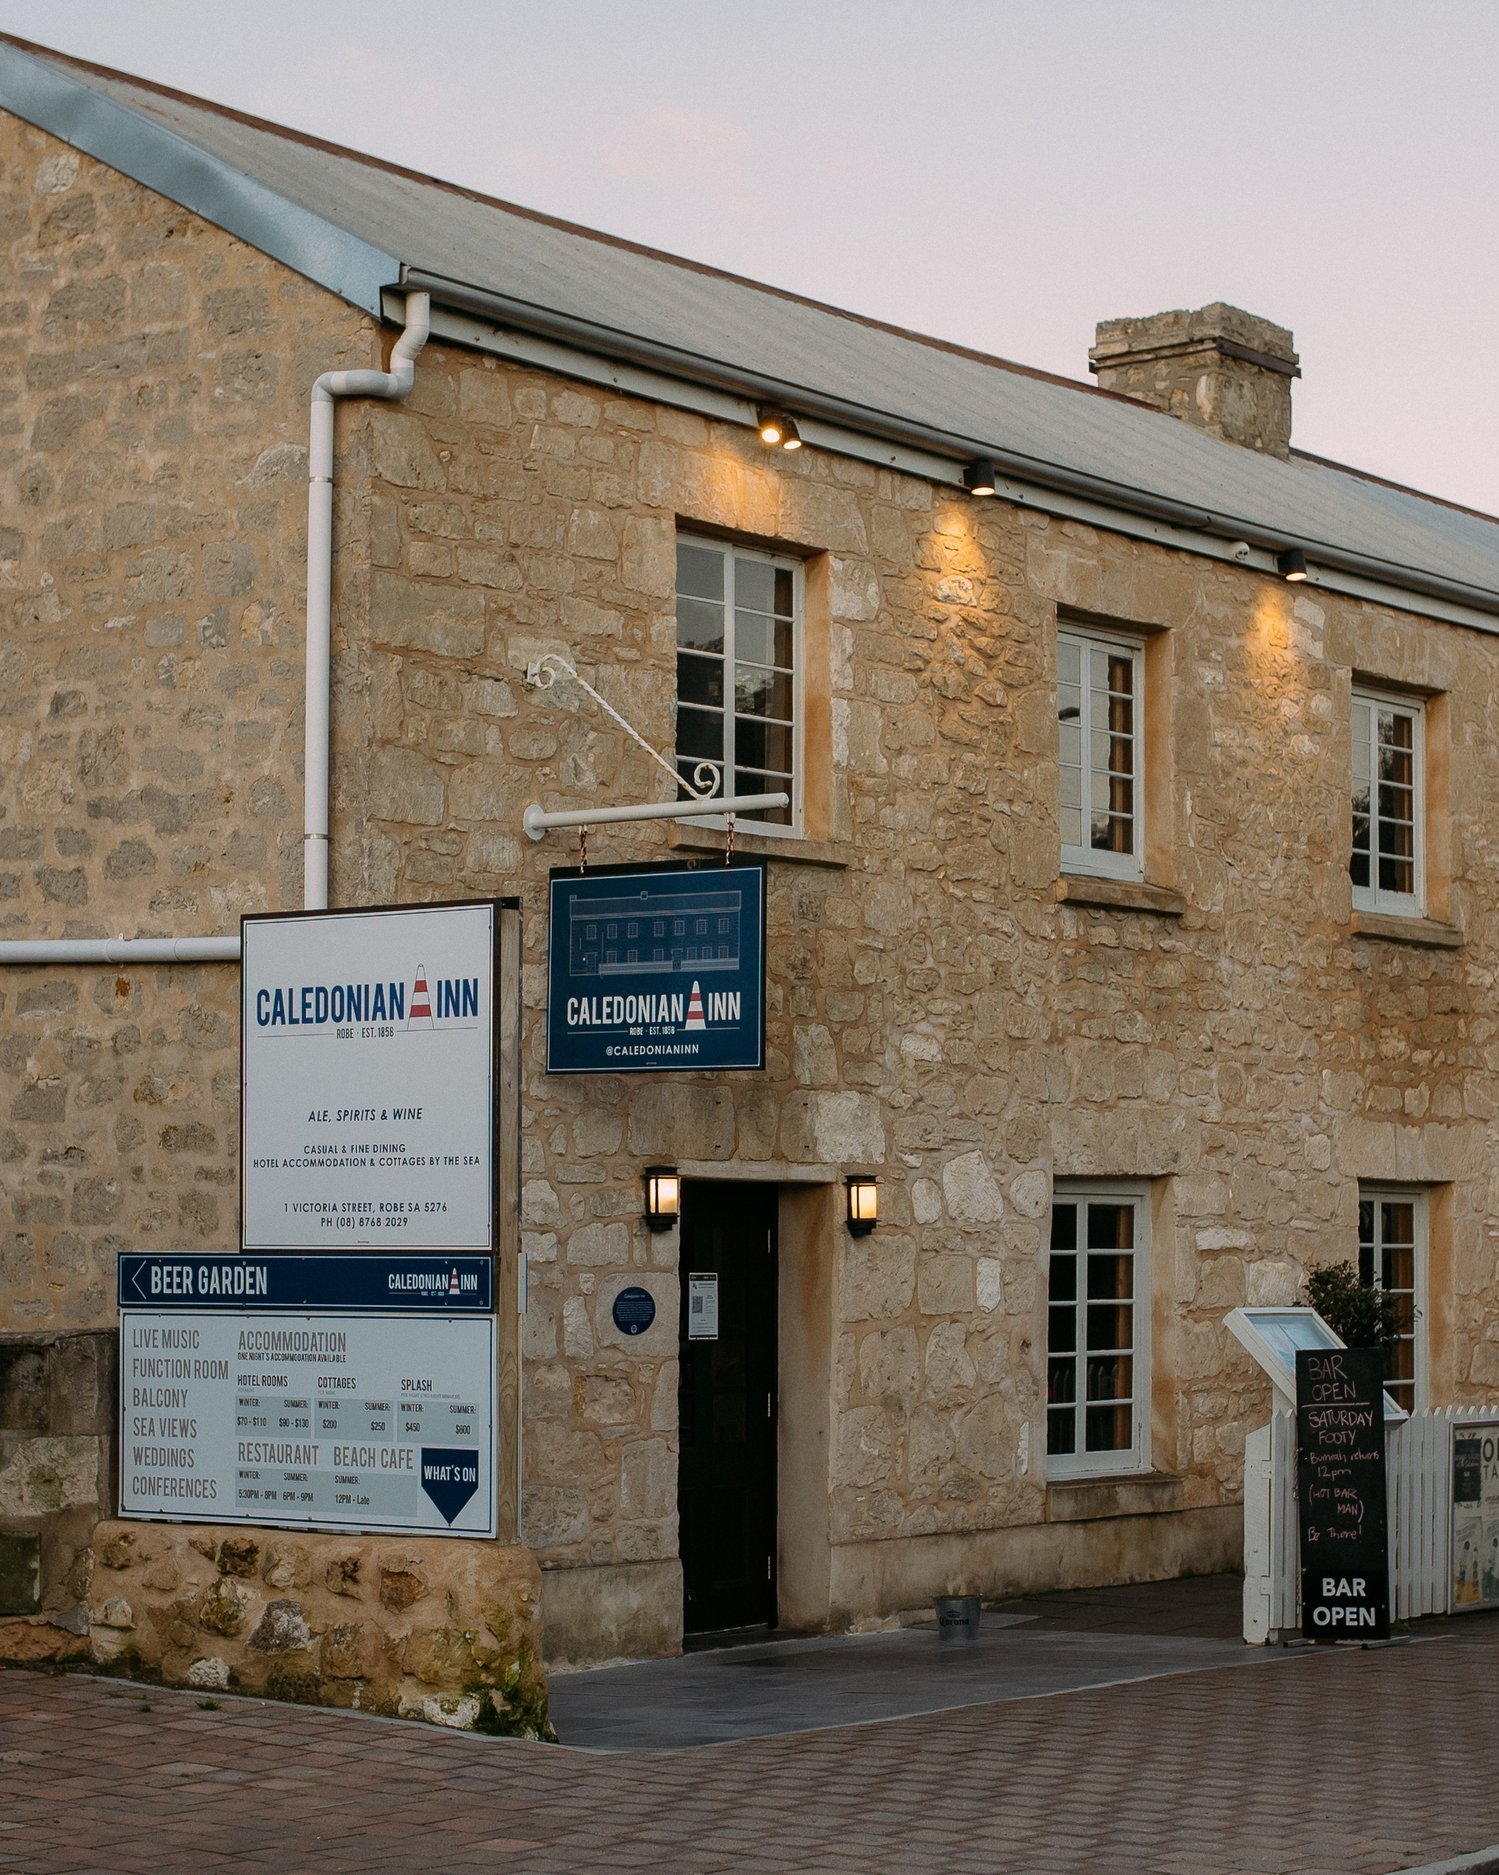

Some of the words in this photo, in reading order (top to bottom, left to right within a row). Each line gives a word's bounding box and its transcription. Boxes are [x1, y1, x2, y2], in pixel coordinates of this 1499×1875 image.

[257, 982, 404, 1026] CALEDONIAN
[437, 978, 478, 1018] INN
[567, 994, 683, 1025] CALEDONIAN
[708, 992, 740, 1021] INN
[337, 1028, 353, 1039] ROBE
[362, 1028, 376, 1038] EST.
[378, 1027, 394, 1037] 1858
[630, 1027, 643, 1035] ROBE
[650, 1027, 661, 1035] EST.
[662, 1026, 675, 1034] 1858
[606, 1044, 699, 1056] @CALEDONIANINN
[308, 1111, 331, 1122] ALE,
[337, 1110, 375, 1121] SPIRITS
[381, 1110, 388, 1120] &
[393, 1108, 422, 1120] WINE
[304, 1145, 338, 1154] CASUAL
[342, 1145, 347, 1153] &
[351, 1145, 369, 1153] FINE
[373, 1144, 405, 1153] DINING
[253, 1160, 279, 1168] HOTEL
[283, 1158, 366, 1167] ACCOMMODATION
[370, 1158, 375, 1166] &
[379, 1157, 425, 1166] COTTAGES
[430, 1157, 440, 1165] BY
[444, 1157, 459, 1165] THE
[464, 1156, 480, 1165] SEA
[285, 1204, 288, 1212] 1
[293, 1203, 338, 1212] VICTORIA
[342, 1203, 375, 1213] STREET,
[379, 1203, 404, 1212] ROBE
[408, 1203, 420, 1212] SA
[424, 1203, 447, 1211] 5276
[321, 1218, 332, 1227] PH
[337, 1217, 355, 1229] (08)
[359, 1218, 381, 1226] 8768
[385, 1218, 408, 1226] 2029
[151, 1266, 193, 1294] BEER
[199, 1266, 267, 1295] GARDEN
[389, 1274, 448, 1289] CALEDONIAN
[461, 1275, 477, 1290] INN
[133, 1329, 158, 1348] LIVE
[162, 1330, 199, 1349] MUSIC
[239, 1331, 346, 1352] ACCOMMODATION
[238, 1352, 248, 1360] ONE
[271, 1353, 316, 1362] ACCOMMODATION
[318, 1354, 346, 1363] AVAILABLE
[133, 1358, 190, 1378] FUNCTION
[194, 1360, 228, 1380] ROOM
[1308, 1355, 1347, 1380] BAR
[238, 1375, 260, 1386] HOTEL
[262, 1376, 288, 1387] ROOMS
[318, 1377, 356, 1389] COTTAGES
[401, 1379, 432, 1391] SPLASH
[1312, 1381, 1356, 1400] OPEN
[133, 1388, 188, 1408] BALCONY
[239, 1399, 260, 1407] WINTER:
[284, 1400, 308, 1408] SUMMER:
[318, 1401, 340, 1409] WINTER:
[365, 1402, 390, 1411] SUMMER:
[401, 1404, 423, 1412] WINTER:
[450, 1406, 476, 1414] SUMMER:
[237, 1417, 247, 1426] $70
[253, 1417, 266, 1426] $110
[279, 1418, 289, 1427] $90
[295, 1419, 309, 1428] $130
[323, 1420, 337, 1429] $200
[1309, 1410, 1373, 1428] SATURDAY
[133, 1418, 155, 1436] SEA
[160, 1418, 197, 1438] VIEWS
[371, 1422, 385, 1431] $250
[406, 1422, 420, 1432] $450
[456, 1425, 470, 1435] $600
[1319, 1430, 1356, 1445] FOOTY
[133, 1447, 194, 1468] WEDDINGS
[239, 1443, 318, 1465] RESTAURANT
[334, 1447, 376, 1467] BEACH
[381, 1448, 413, 1470] CAFE
[239, 1471, 260, 1479] WINTER:
[284, 1473, 308, 1481] SUMMER:
[463, 1467, 476, 1482] ON
[1318, 1466, 1351, 1480] 12pm
[335, 1475, 360, 1484] SUMMER:
[133, 1476, 217, 1499] CONFERENCES
[1334, 1488, 1357, 1499] BAR
[239, 1489, 259, 1499] 5:30PM
[265, 1491, 276, 1500] 8PM
[283, 1491, 295, 1501] 6PM
[301, 1493, 313, 1501] 9PM
[336, 1495, 351, 1503] 12PM
[357, 1495, 369, 1504] Late
[1308, 1526, 1320, 1541] Be
[1322, 1578, 1366, 1596] BAR
[939, 1615, 969, 1627] Corona
[1313, 1607, 1375, 1626] OPEN
